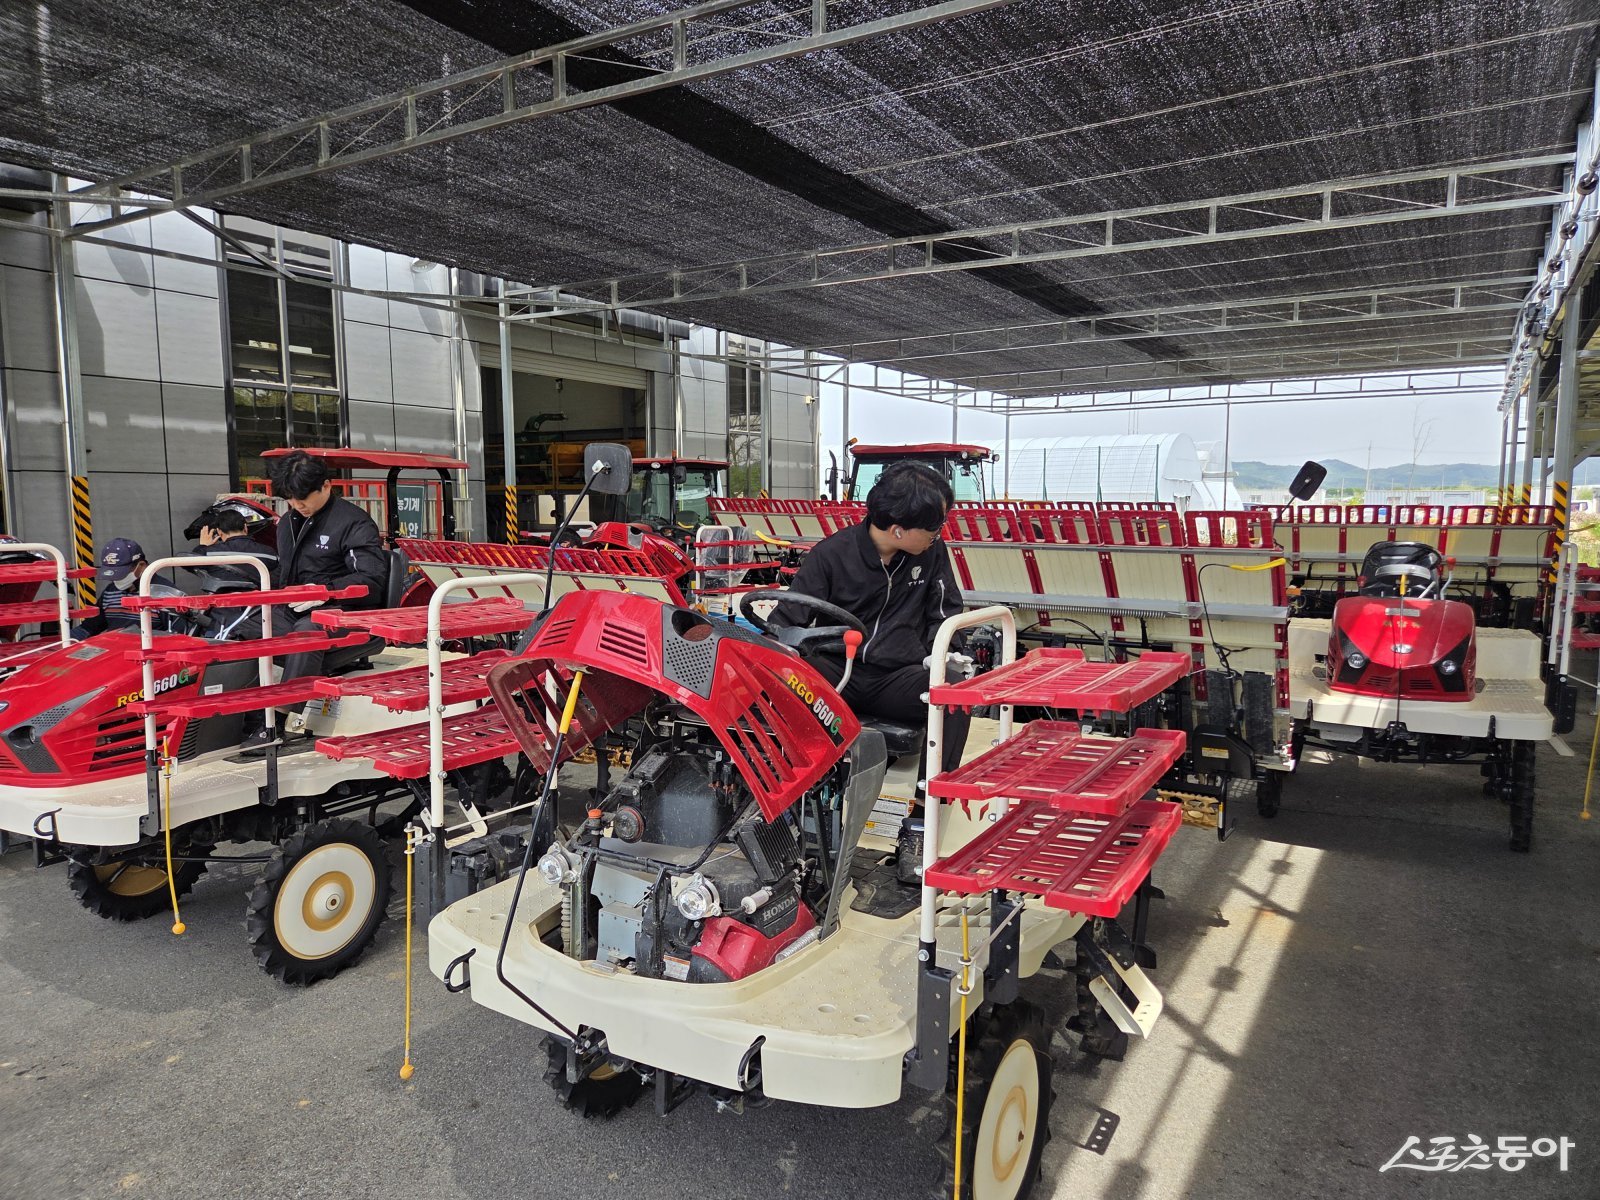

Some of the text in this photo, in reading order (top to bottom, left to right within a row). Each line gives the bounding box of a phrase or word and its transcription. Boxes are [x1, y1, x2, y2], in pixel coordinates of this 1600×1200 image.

[907, 579, 925, 587] TYM
[787, 674, 814, 704] RGO
[762, 895, 796, 921] HONDA
